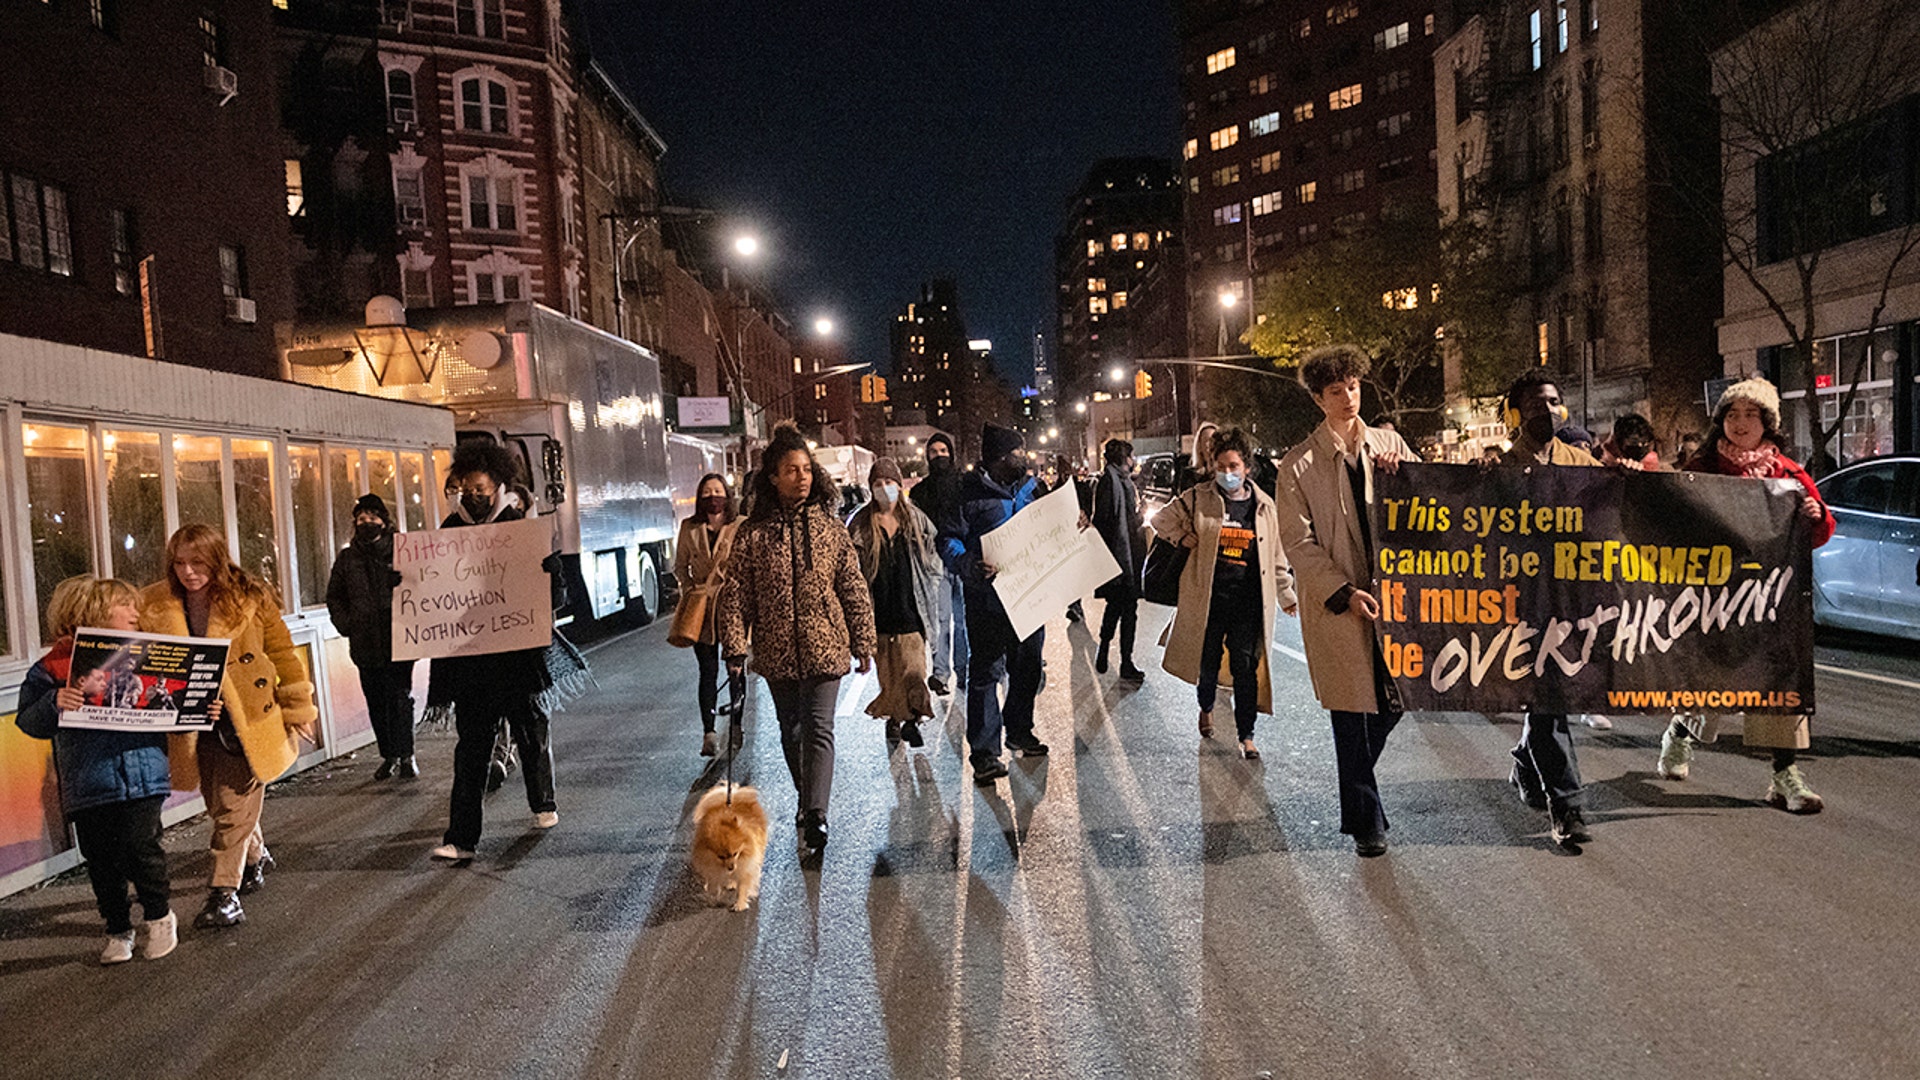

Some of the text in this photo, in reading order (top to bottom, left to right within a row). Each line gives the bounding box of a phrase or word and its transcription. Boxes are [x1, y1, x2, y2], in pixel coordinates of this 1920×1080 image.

[1383, 496, 1584, 538] This system
[394, 533, 514, 564] Rittenhouse
[1379, 543, 1486, 579] cannot
[1499, 546, 1540, 579] be
[1554, 540, 1732, 586] REFORMED
[454, 557, 508, 584] Guilty
[1381, 579, 1521, 625] It must
[404, 609, 535, 645] NOTHING LESS!
[1383, 565, 1793, 694] be OVERTHROWN!
[1608, 690, 1801, 708] www.revcom.us
